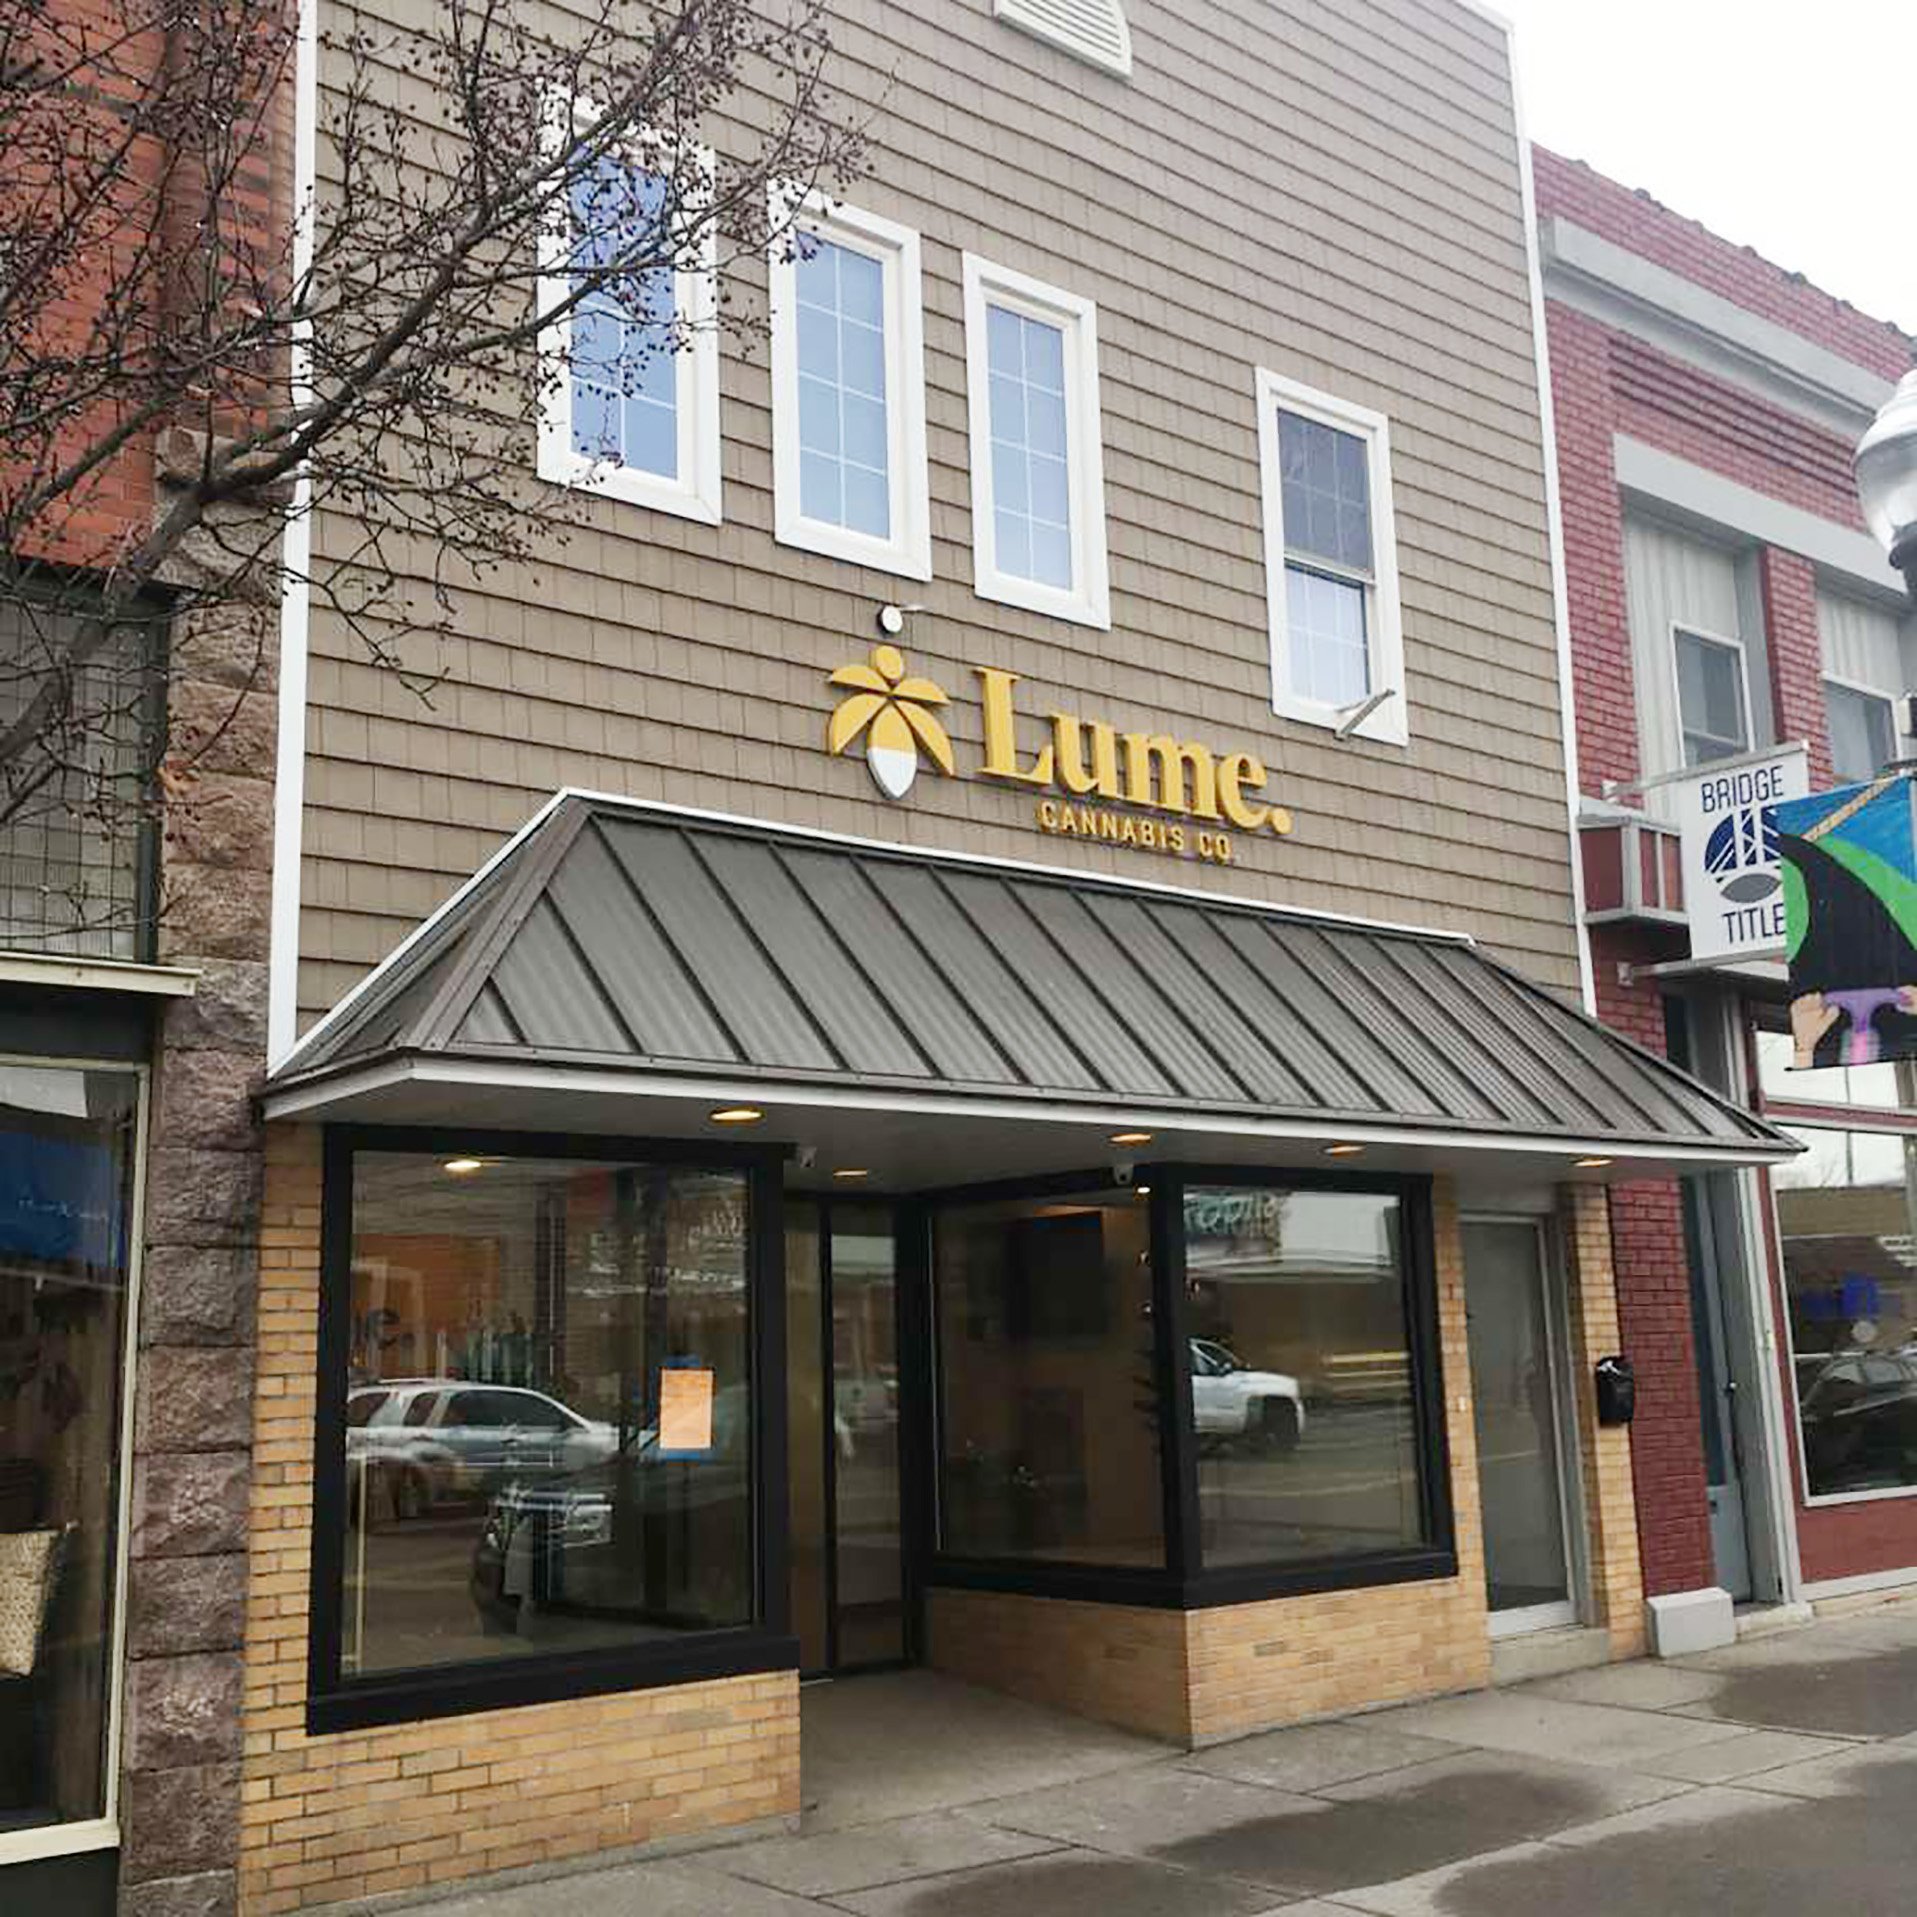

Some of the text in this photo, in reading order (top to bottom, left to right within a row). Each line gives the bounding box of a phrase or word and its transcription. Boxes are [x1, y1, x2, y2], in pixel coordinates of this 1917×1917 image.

[974, 665, 1293, 835] Lume.
[1702, 765, 1784, 813] BRIDGE
[1039, 801, 1186, 851] CANNABIS
[1722, 903, 1786, 944] TITLE
